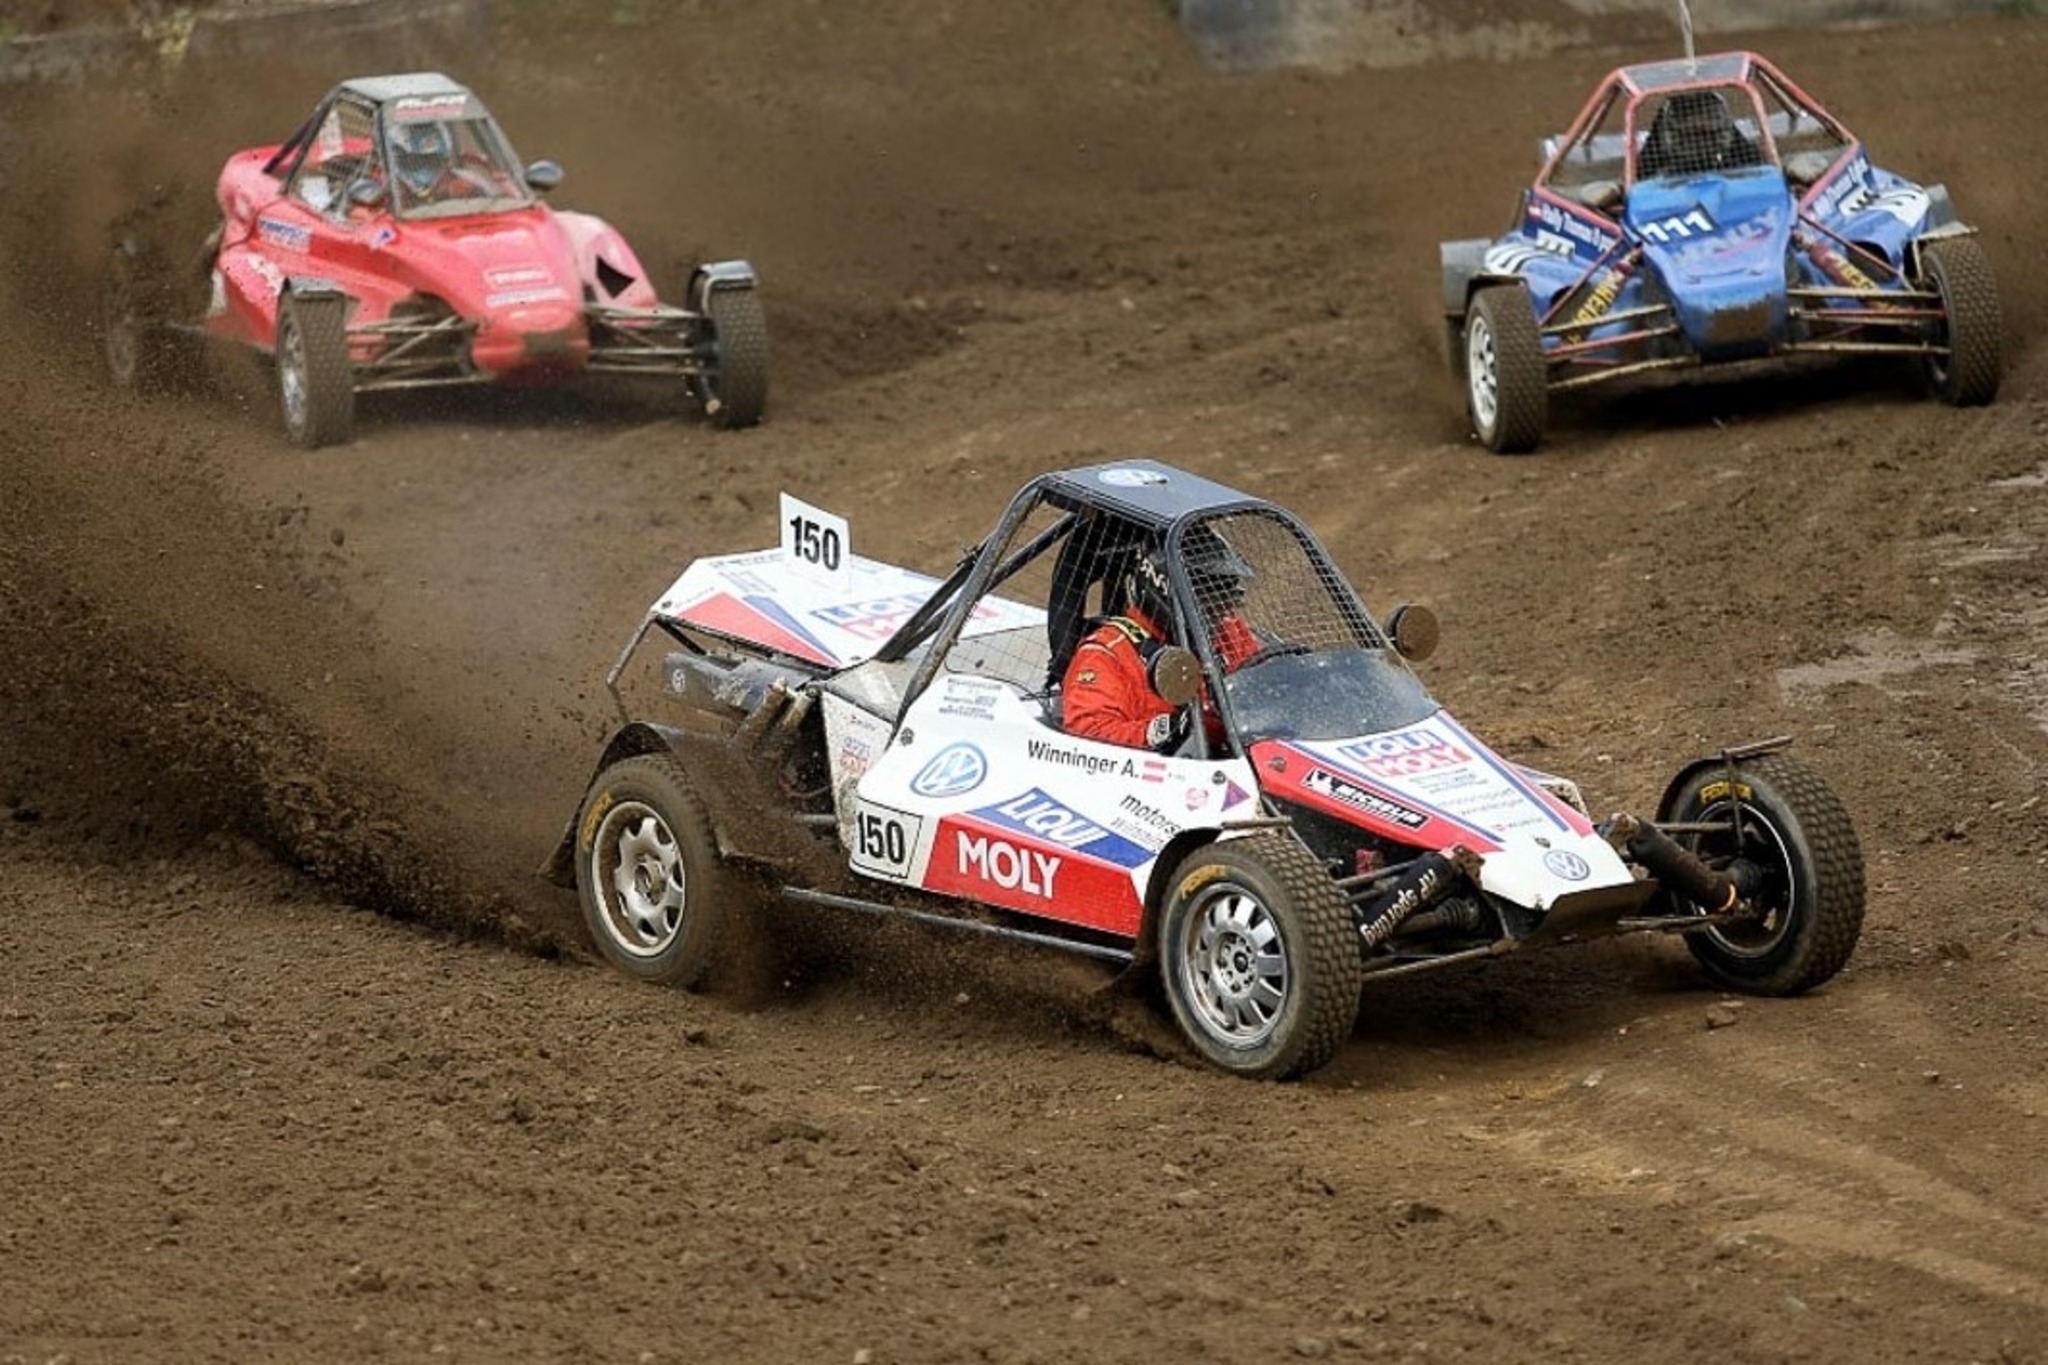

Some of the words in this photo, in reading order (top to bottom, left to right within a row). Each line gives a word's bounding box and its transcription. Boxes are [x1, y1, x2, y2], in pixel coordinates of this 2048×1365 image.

[1638, 210, 1715, 242] 111
[789, 515, 840, 571] 150
[1028, 739, 1118, 775] Winninger
[1120, 758, 1139, 778] A.
[856, 810, 905, 865] 150
[995, 792, 1110, 849] LIQUI
[956, 829, 1061, 900] MOLY
